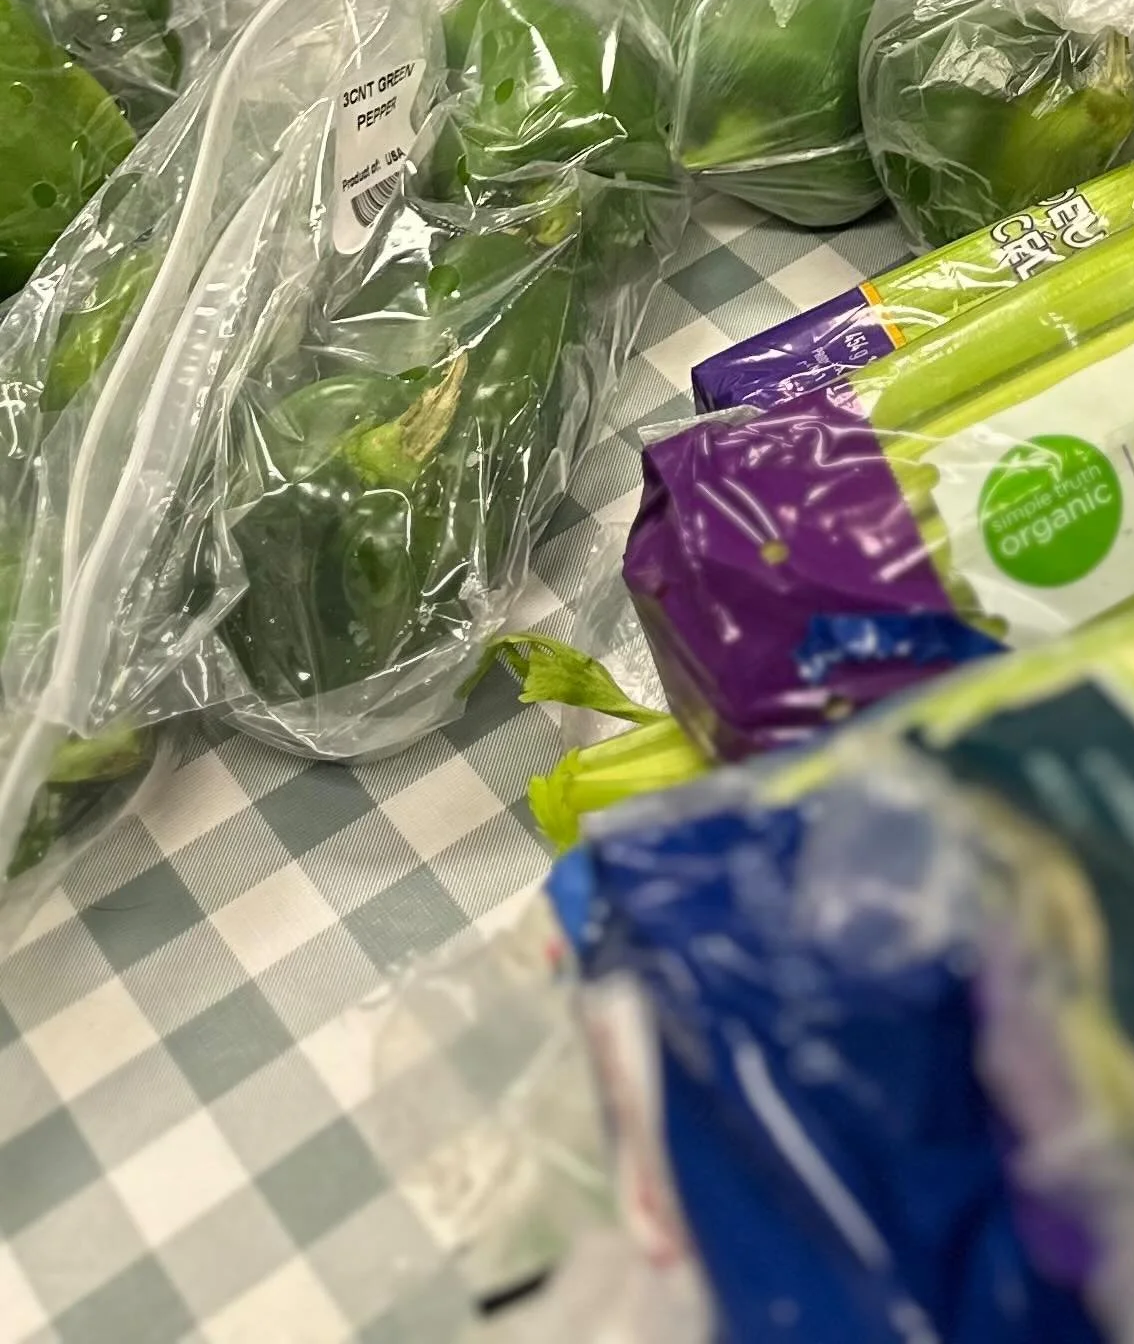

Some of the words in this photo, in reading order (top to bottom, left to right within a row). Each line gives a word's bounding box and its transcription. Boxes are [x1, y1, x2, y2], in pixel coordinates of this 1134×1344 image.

[343, 81, 374, 108] 3CNT
[378, 63, 415, 93] GREEN
[357, 96, 397, 131] PEPPER
[342, 165, 370, 192] Product
[385, 147, 406, 166] USA
[845, 331, 869, 352] 454
[990, 492, 1053, 535] simple
[1053, 463, 1102, 497] truth
[999, 481, 1113, 559] organic
